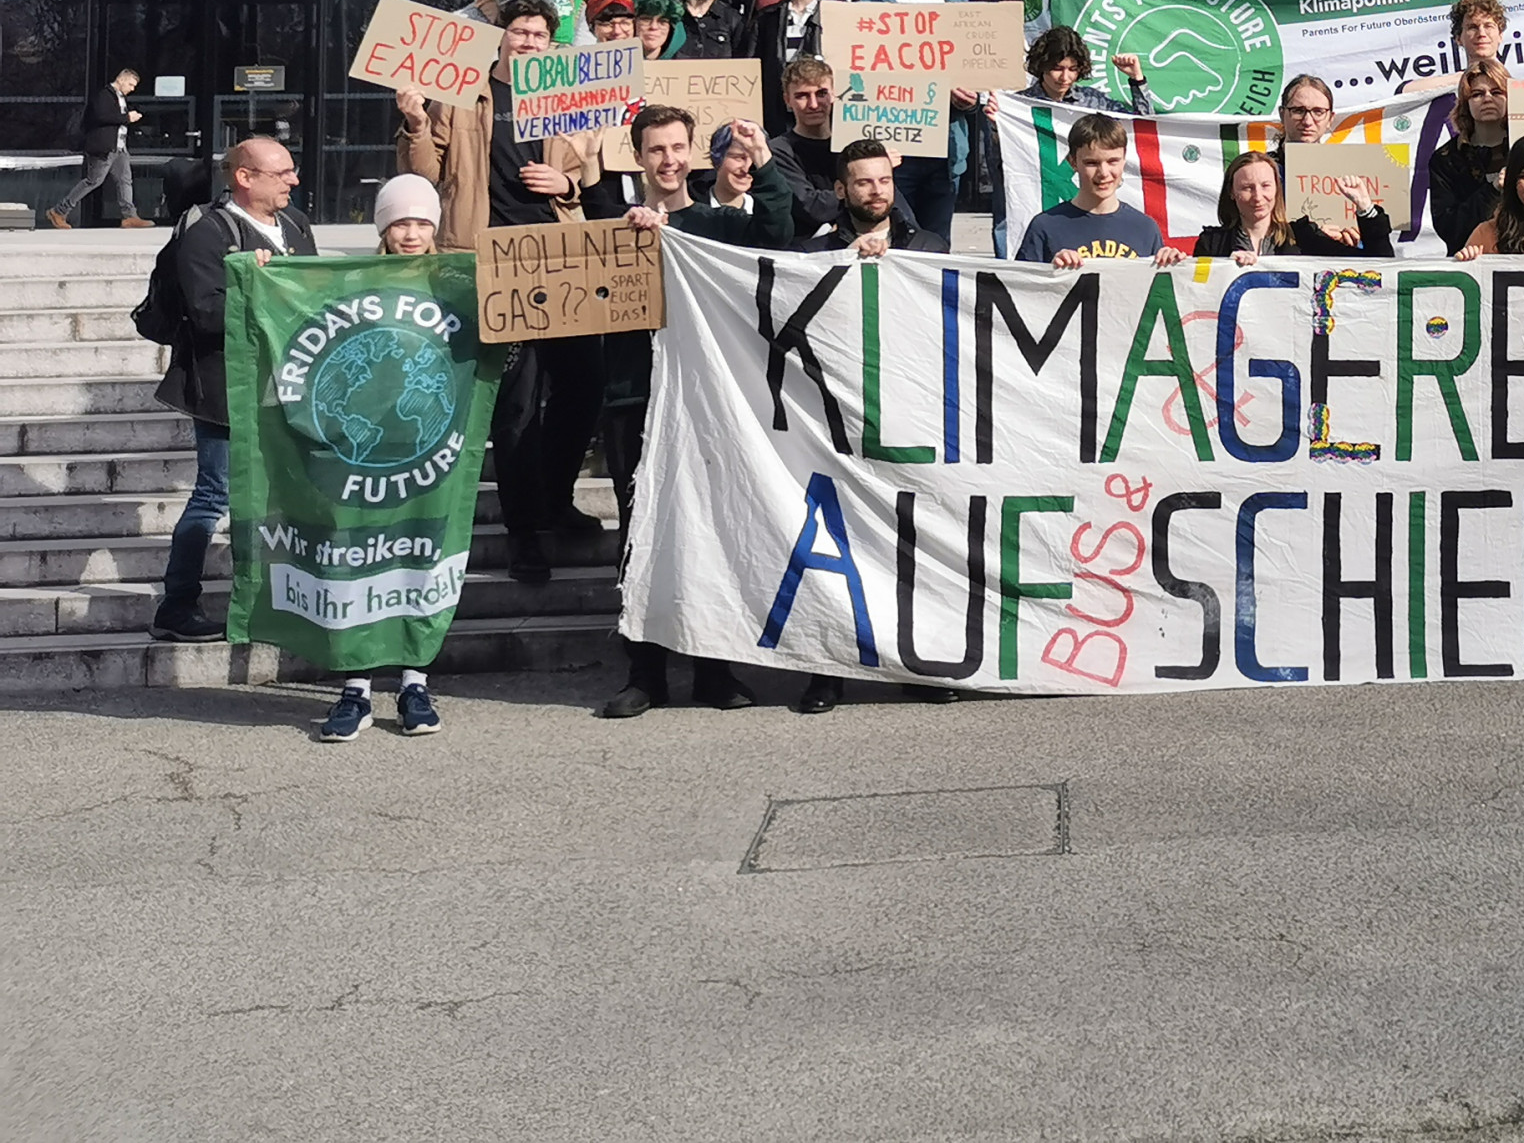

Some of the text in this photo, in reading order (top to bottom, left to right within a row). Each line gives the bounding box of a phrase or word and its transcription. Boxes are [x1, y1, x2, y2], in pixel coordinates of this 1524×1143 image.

[857, 11, 940, 35] #STOP
[958, 10, 981, 18] EAST
[400, 11, 475, 57] STOP
[966, 30, 998, 39] CRUDE
[1302, 26, 1339, 37] Parents
[1342, 23, 1358, 32] For
[1361, 20, 1392, 31] Future
[850, 40, 955, 71] EACOP
[972, 43, 997, 55] OIL
[364, 42, 481, 95] EACOP
[962, 58, 1008, 69] PIPELINE
[687, 75, 758, 96] EVERY
[876, 85, 914, 103] KEIN
[517, 86, 630, 118] AUTOBAHNBAU
[516, 108, 618, 139] VERHINDERT!
[842, 103, 939, 127] KLIMASCHUTZ
[862, 124, 922, 143] GESETZ
[492, 226, 656, 278] MOLLNER
[610, 272, 652, 289] SPART
[610, 290, 647, 304] EUCH
[610, 305, 647, 323] DAS!
[278, 295, 462, 402] FRIDAYS FOR
[341, 431, 465, 503] FUTURE
[258, 523, 442, 568] Wir streiken,
[756, 472, 1075, 681] AUF
[285, 573, 308, 612] bis
[315, 587, 355, 620] Ihr
[1041, 520, 1146, 688] BUS
